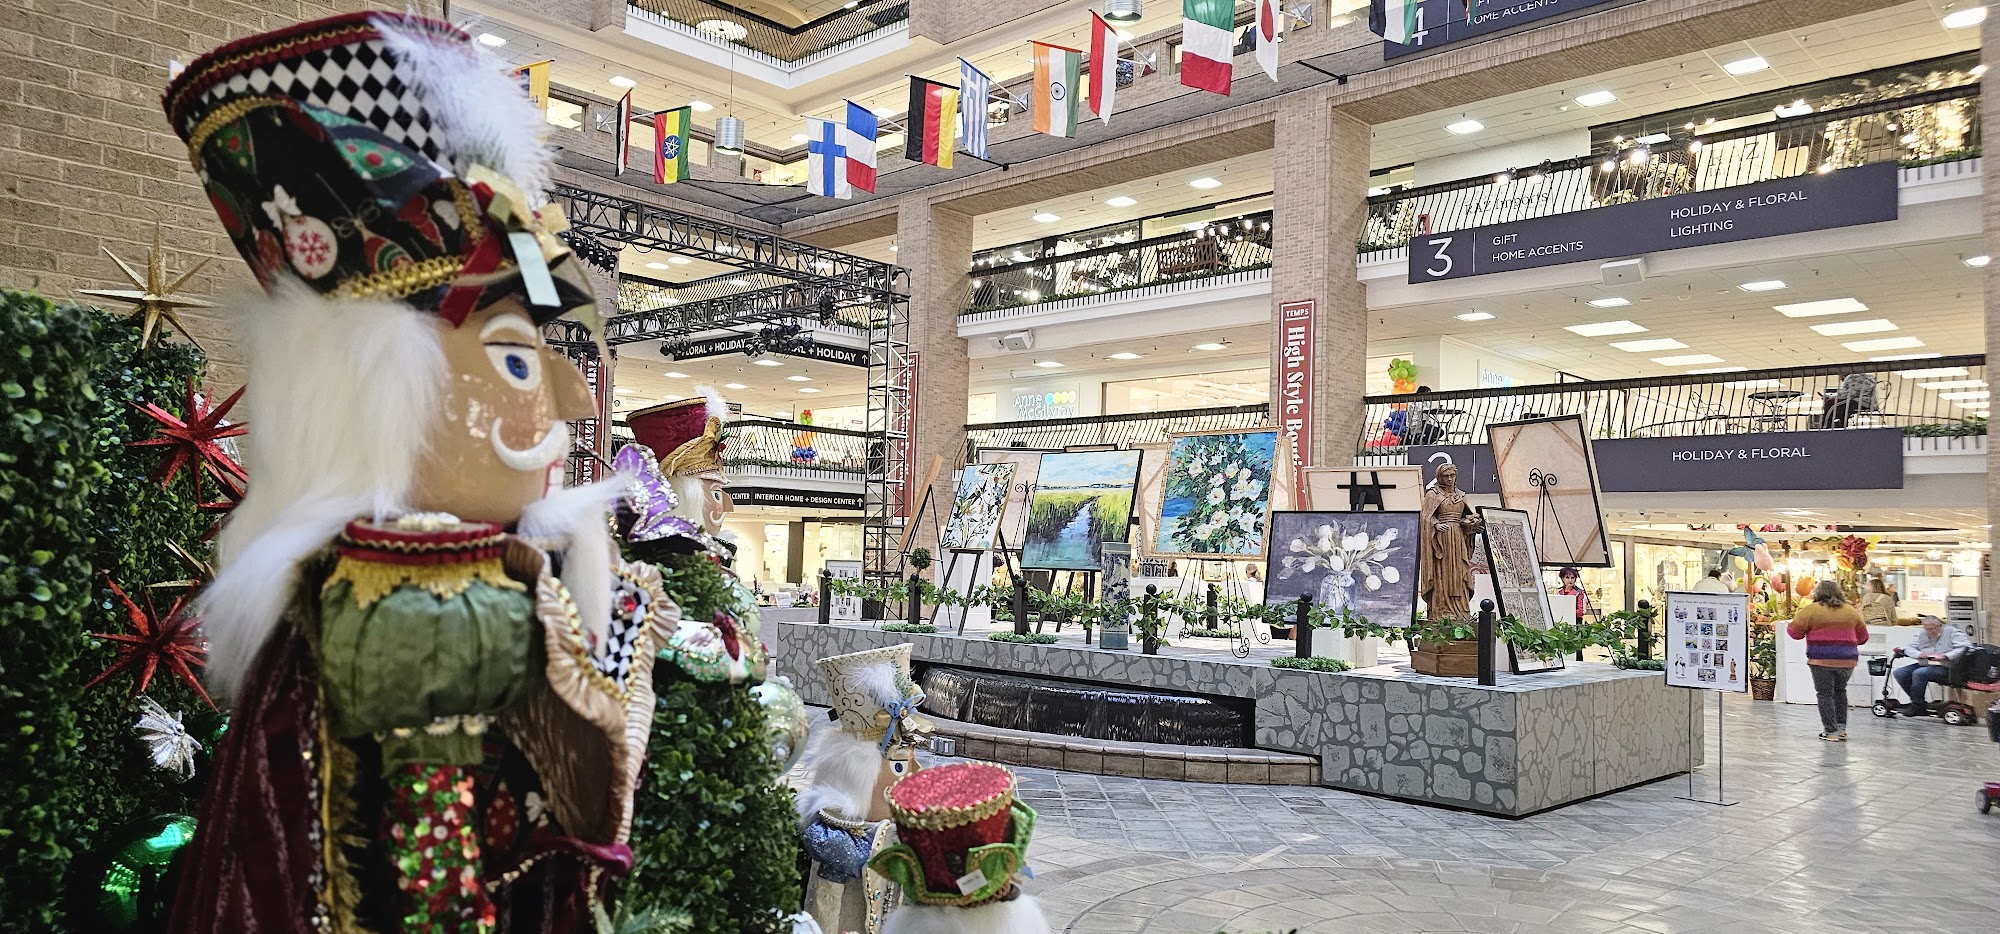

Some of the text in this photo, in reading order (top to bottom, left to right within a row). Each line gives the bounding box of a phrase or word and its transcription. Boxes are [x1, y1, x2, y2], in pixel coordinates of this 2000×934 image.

[1670, 190, 1808, 220] HOLIDAY & FLORAL
[1670, 219, 1734, 238] LIGHTING
[1492, 233, 1518, 246] GIFT
[1426, 236, 1453, 278] 3
[1492, 240, 1584, 263] HOME ACCENTS
[1286, 308, 1309, 318] TEMPS
[715, 338, 746, 352] HOLIDAY
[1284, 325, 1306, 369] High
[816, 346, 857, 362] HOLIDAY
[1013, 392, 1043, 408] Anne
[1283, 371, 1305, 415] Style
[1672, 446, 1811, 461] HOLIDAY & FLORAL
[731, 492, 751, 500] CENTER
[754, 492, 783, 502] INTERIOR
[784, 494, 804, 503] HOME
[810, 496, 833, 504] DESIGN
[833, 497, 856, 506] CENTER
